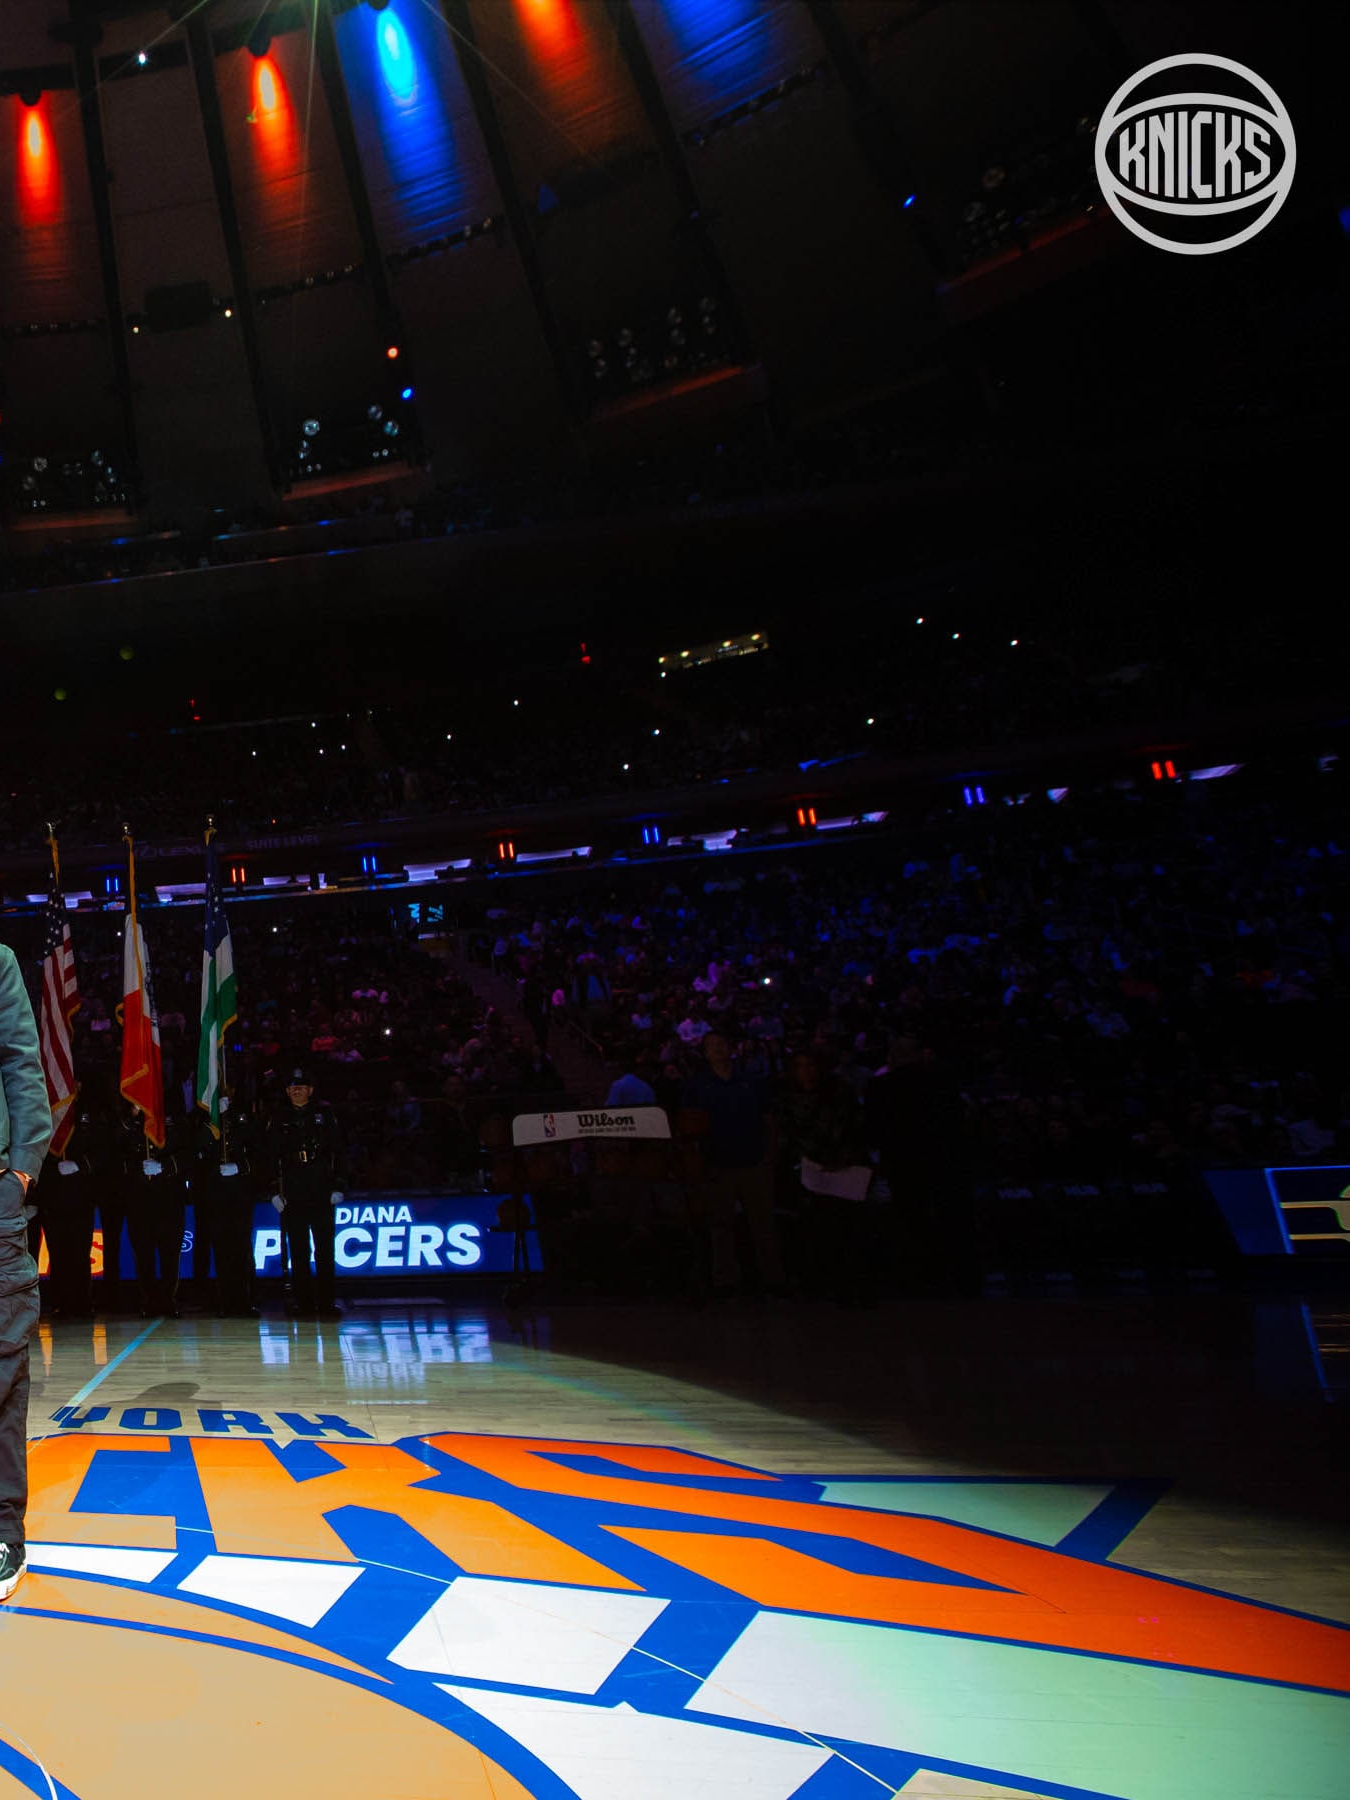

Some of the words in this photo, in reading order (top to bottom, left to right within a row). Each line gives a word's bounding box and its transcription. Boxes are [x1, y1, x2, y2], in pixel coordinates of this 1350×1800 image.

[577, 1112, 635, 1127] Wilson
[335, 1205, 412, 1225] DIANA
[253, 1223, 481, 1269] PCERS
[49, 1406, 375, 1439] YORK
